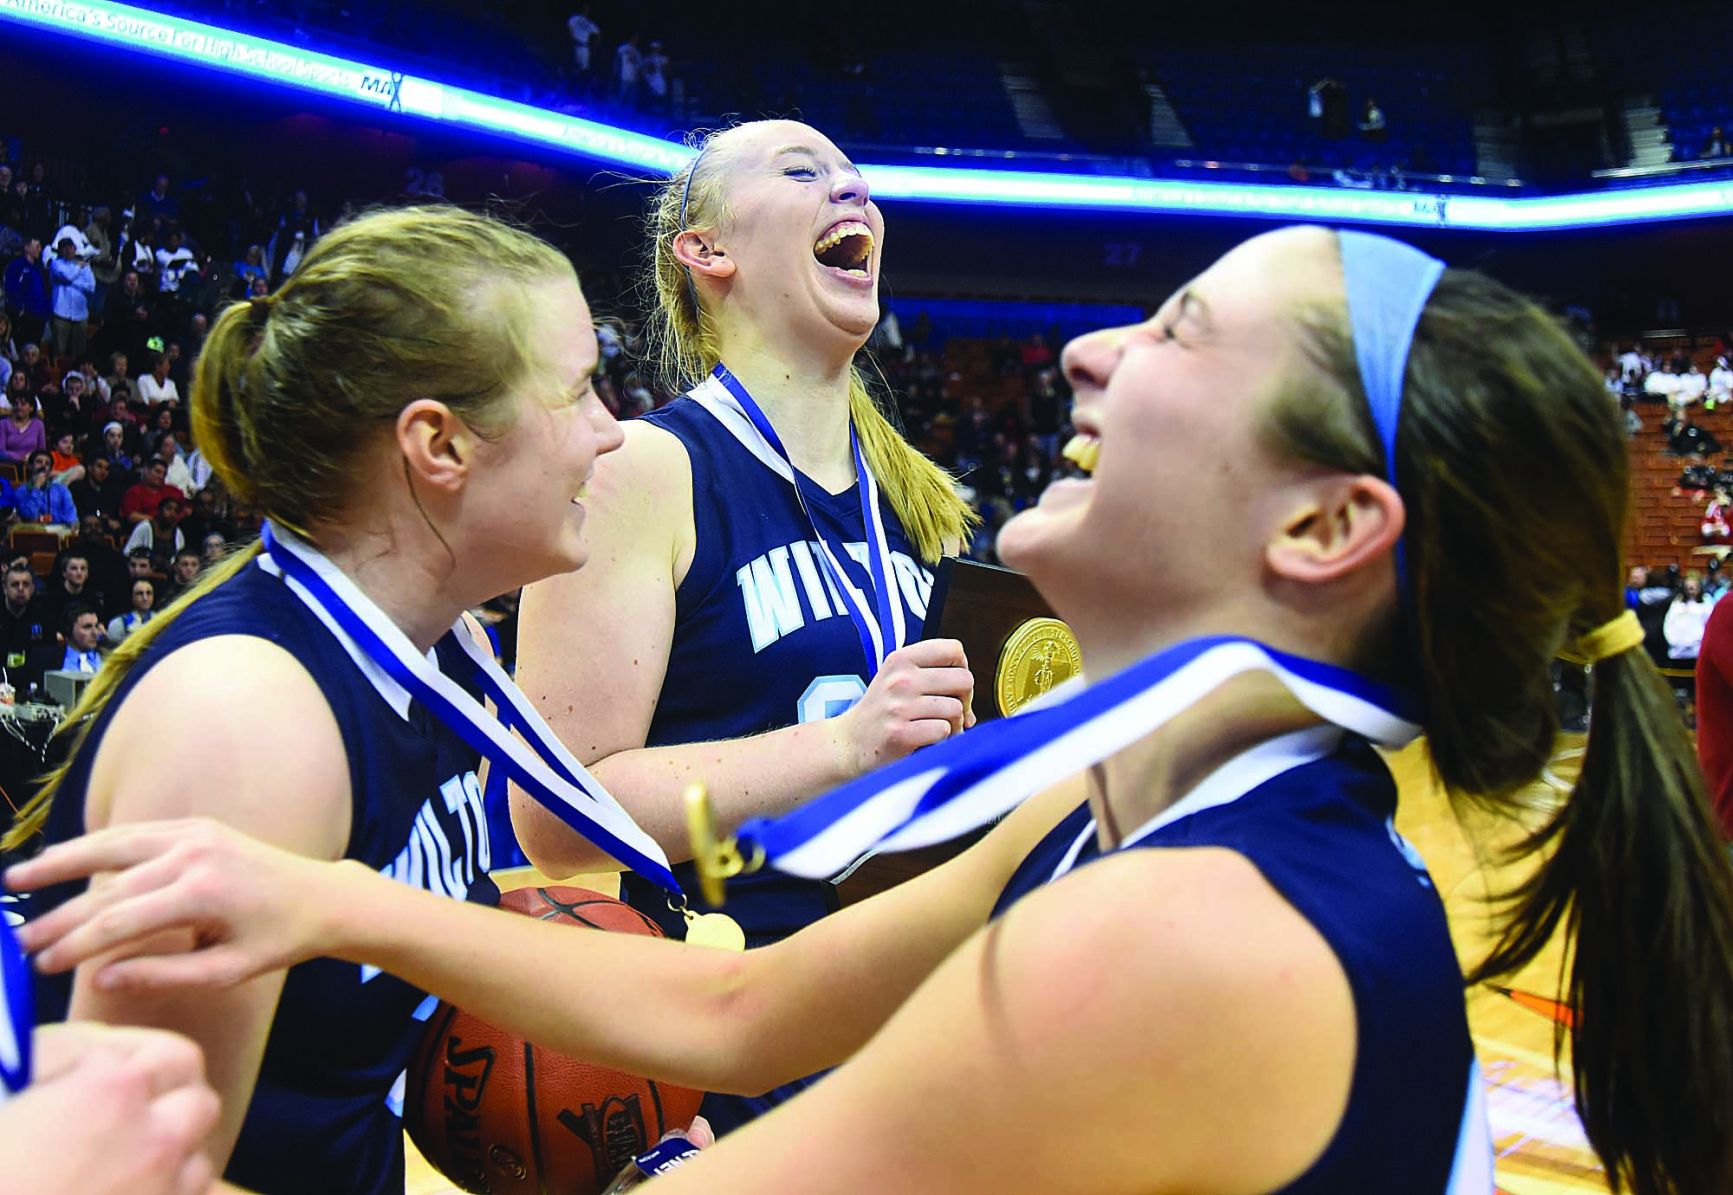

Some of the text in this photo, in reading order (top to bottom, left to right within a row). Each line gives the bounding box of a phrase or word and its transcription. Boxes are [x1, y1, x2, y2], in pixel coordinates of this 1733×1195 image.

[106, 13, 168, 43] Source
[201, 37, 242, 61] High
[245, 47, 299, 75] School
[735, 539, 935, 655] WILO
